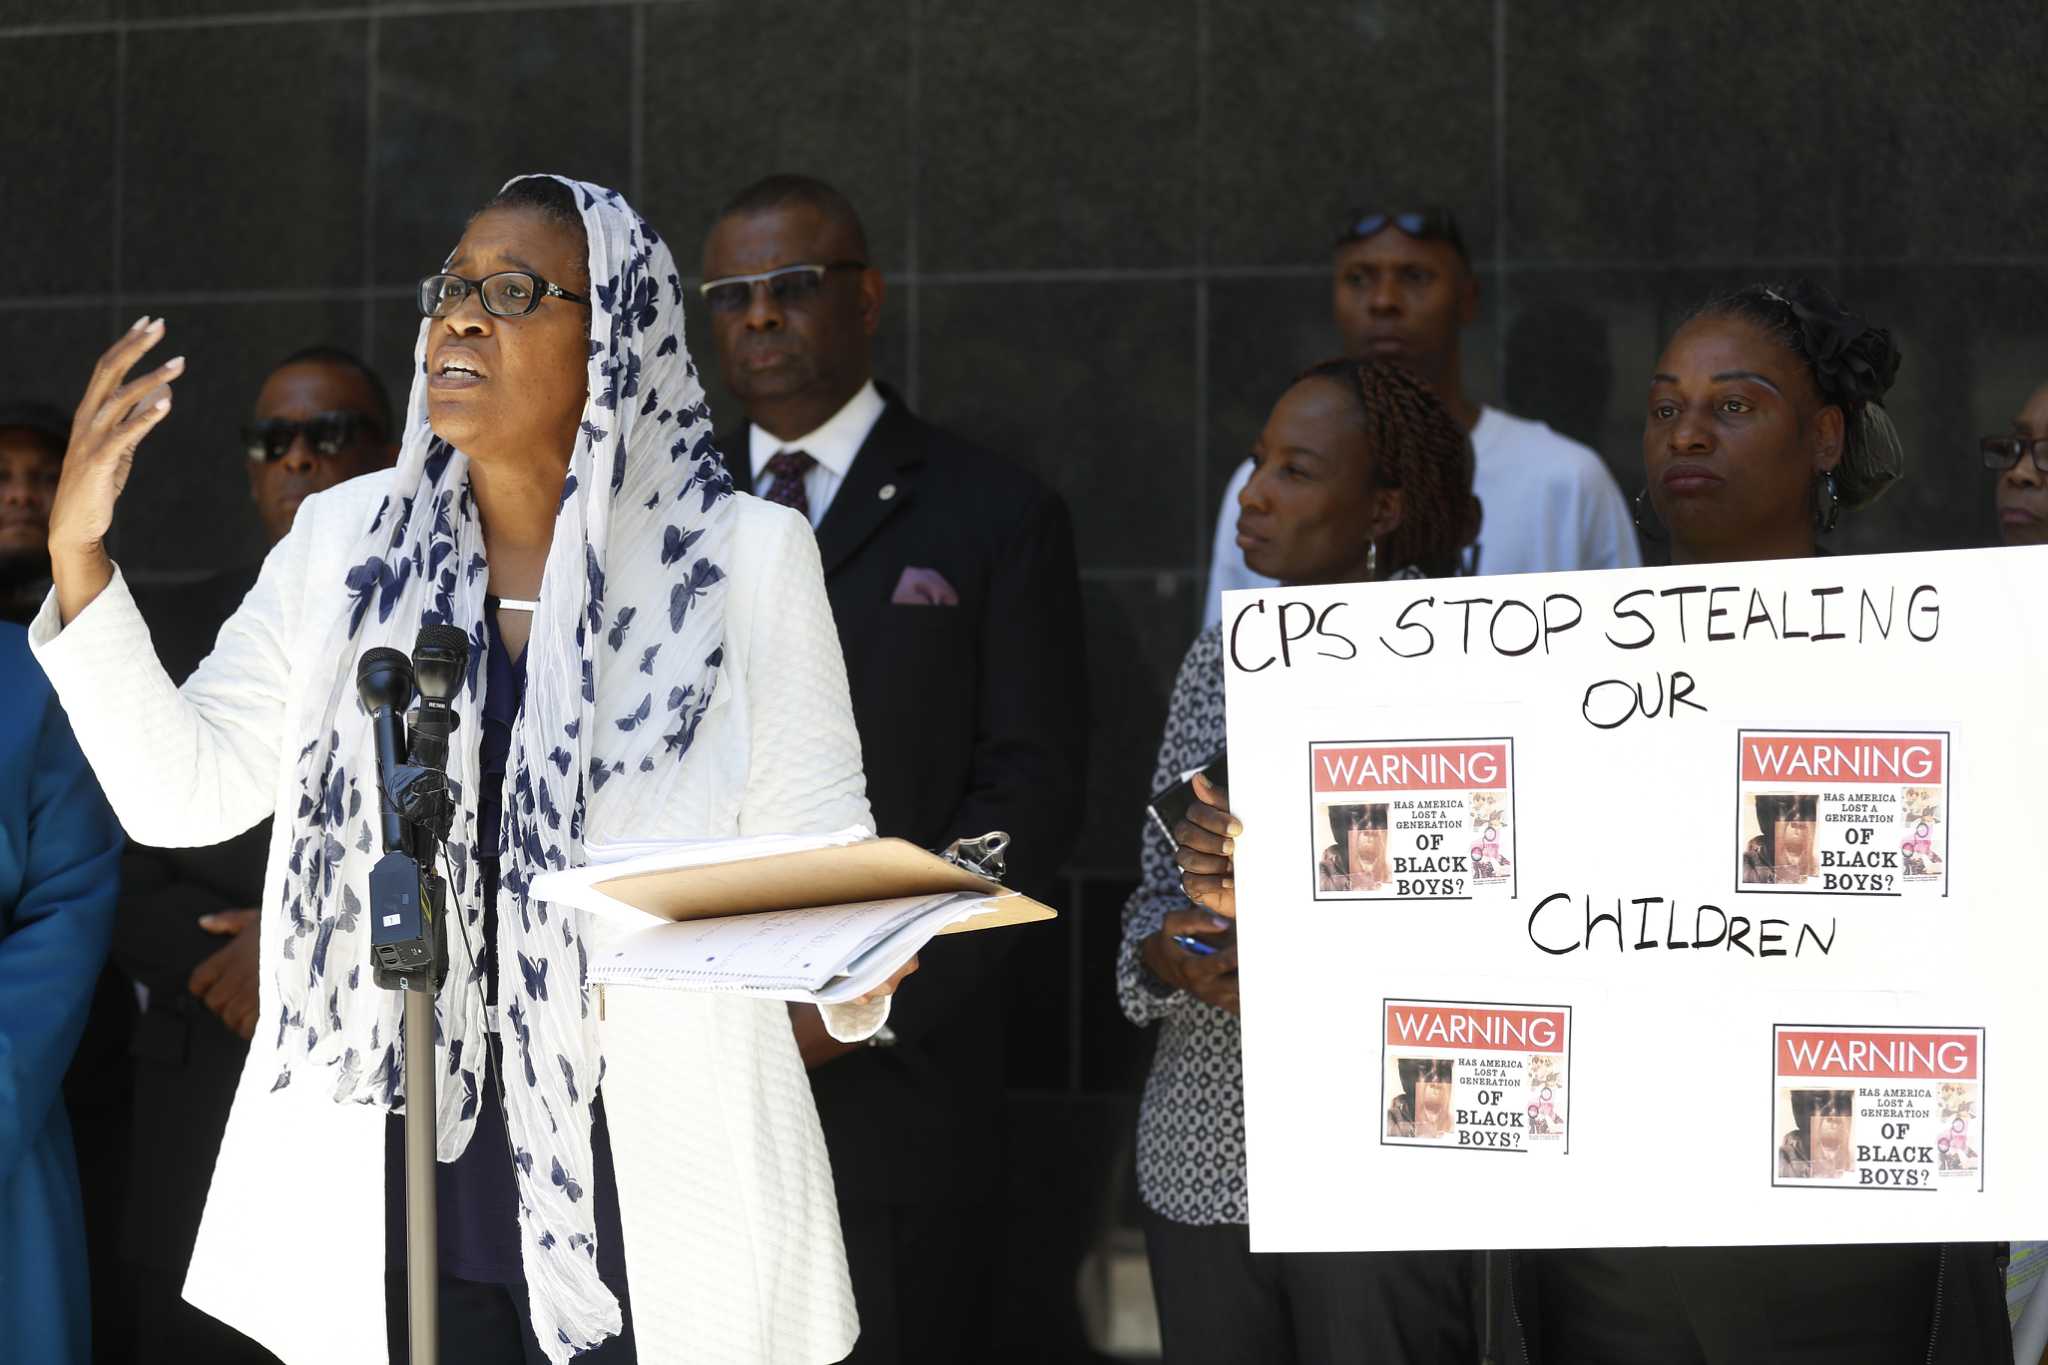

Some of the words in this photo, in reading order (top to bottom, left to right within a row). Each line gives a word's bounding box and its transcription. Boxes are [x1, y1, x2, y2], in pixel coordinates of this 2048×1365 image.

[1231, 600, 1356, 672] CPS
[1380, 594, 1582, 658] STOP
[1606, 585, 1940, 650] STEALING
[1583, 671, 1707, 729] OUR
[1323, 752, 1498, 785] WARNING
[1752, 745, 1933, 778] WARNING
[1394, 801, 1414, 809] HAS
[1417, 800, 1464, 809] AMERICA
[1824, 793, 1845, 802] HAS
[1848, 793, 1896, 802] AMERICA
[1412, 811, 1437, 819] LOST
[1841, 804, 1868, 812] LOST
[1871, 804, 1878, 812] A
[1396, 820, 1462, 830] GENERATION
[1825, 814, 1894, 823] GENERATION
[1416, 834, 1444, 850] OF
[1845, 828, 1874, 845] OF
[1394, 856, 1468, 873] BLACK
[1821, 851, 1898, 868] BLACK
[1397, 878, 1464, 896] BOYS?
[1823, 873, 1894, 891] BOYS?
[1528, 893, 1836, 957] CHILDREN
[1395, 1012, 1556, 1047] WARNING
[1458, 1058, 1477, 1066] HAS
[1480, 1059, 1523, 1068] AMERICA
[1787, 1040, 1968, 1074] WARNING
[1475, 1068, 1498, 1077] LOST
[1500, 1069, 1506, 1077] A
[1460, 1077, 1521, 1087] GENERATION
[1478, 1090, 1503, 1106] OF
[1859, 1088, 1881, 1097] HAS
[1883, 1089, 1932, 1098] AMERICA
[1877, 1099, 1904, 1107] LOST
[1907, 1100, 1914, 1108] A
[1456, 1110, 1524, 1128] BLACK
[1861, 1109, 1930, 1119] GENERATION
[1458, 1130, 1521, 1148] BOYS?
[1881, 1123, 1910, 1140] OF
[1857, 1145, 1934, 1163] BLACK
[1859, 1168, 1930, 1186] BOYS?
